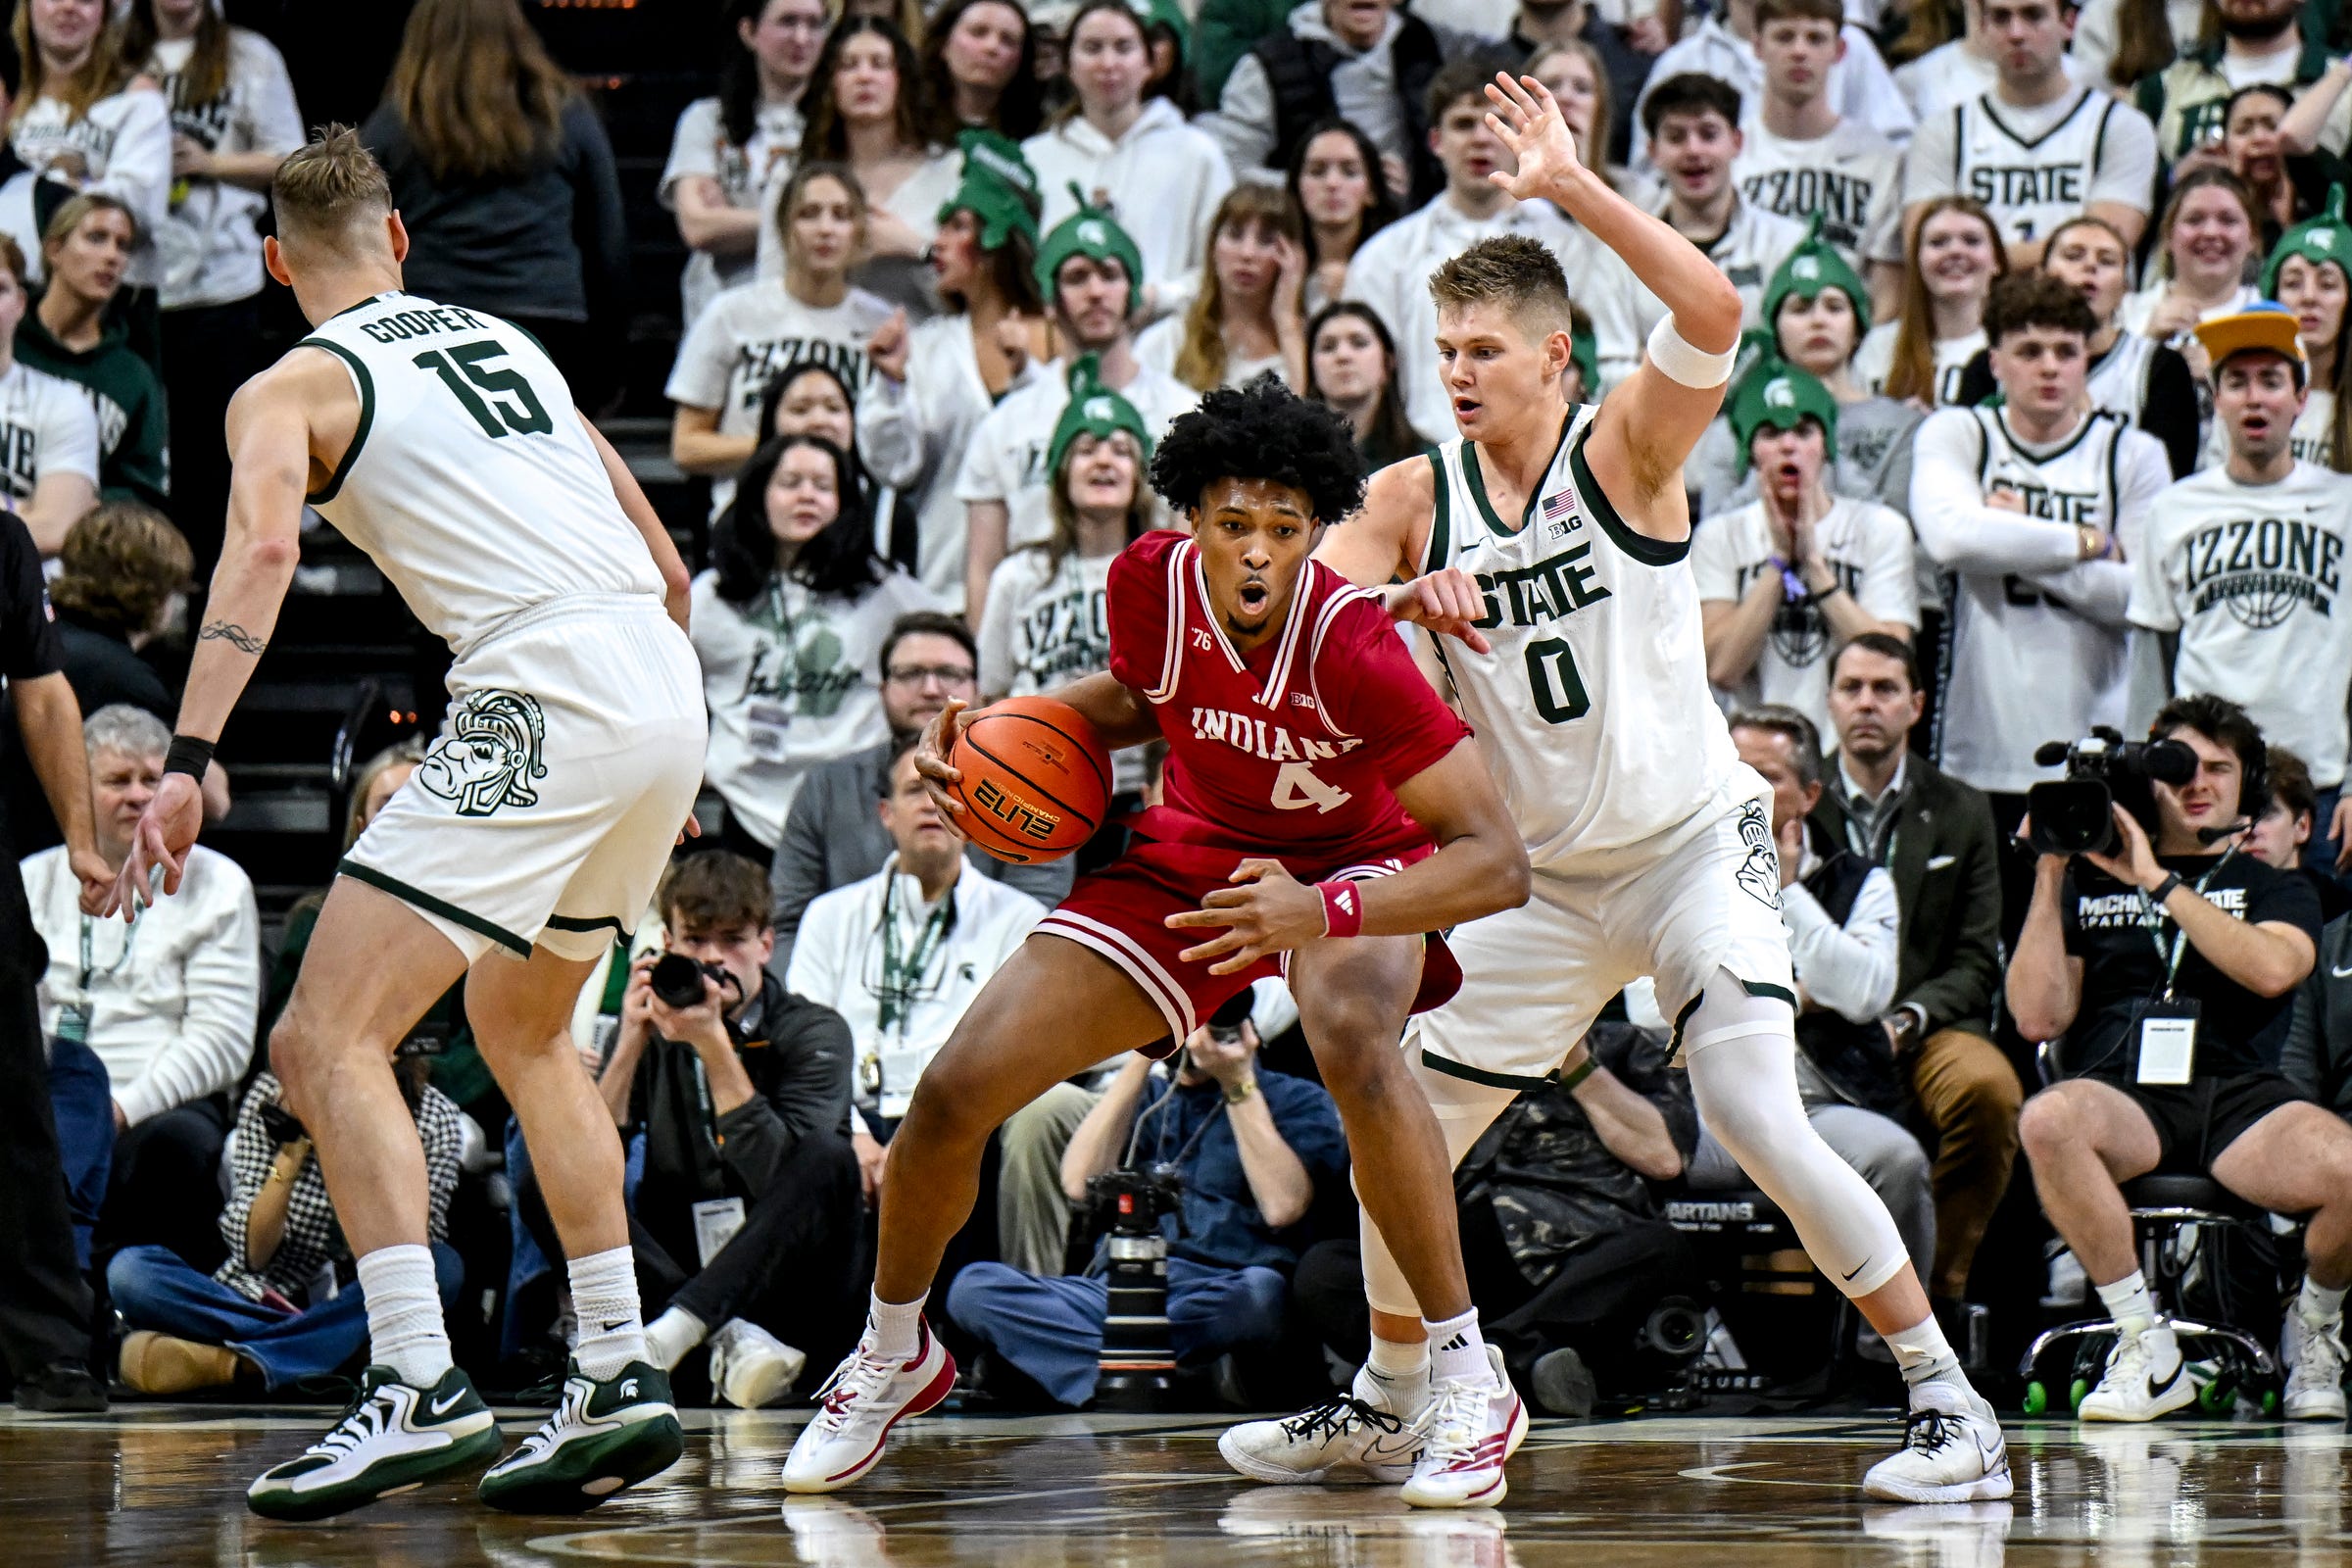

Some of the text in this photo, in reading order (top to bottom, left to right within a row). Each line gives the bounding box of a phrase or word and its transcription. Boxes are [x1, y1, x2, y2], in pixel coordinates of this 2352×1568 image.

[1742, 169, 1873, 227] ZZONE
[1972, 163, 2082, 206] STATE
[360, 308, 489, 343] COOPER
[412, 339, 553, 438] 15
[1470, 540, 1613, 629] STATE
[2184, 517, 2344, 595] IZZONE
[1020, 589, 1107, 656] IZZO
[1524, 636, 1592, 725] 0
[1192, 707, 1363, 761] INDIANA
[973, 778, 1057, 842] ELITE
[1270, 760, 1353, 815] 4
[2079, 893, 2171, 917] MICHI
[1666, 1201, 1755, 1221] ARTANS
